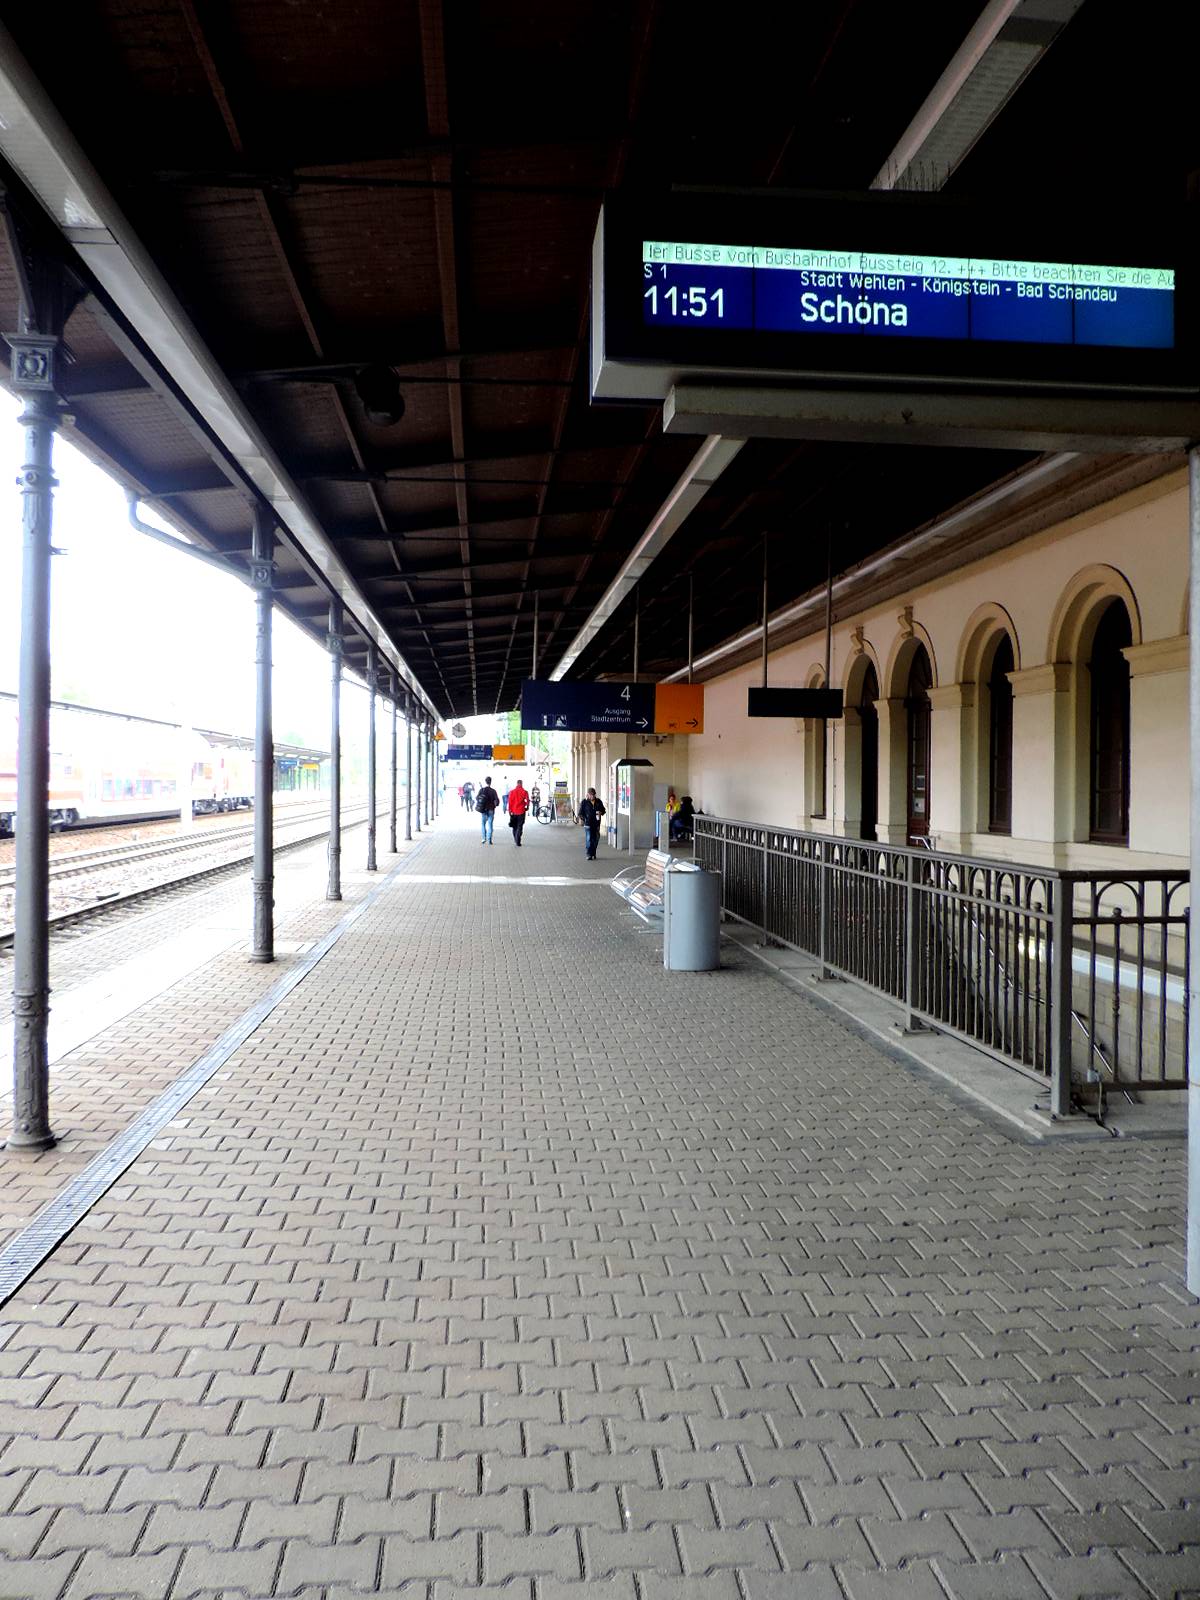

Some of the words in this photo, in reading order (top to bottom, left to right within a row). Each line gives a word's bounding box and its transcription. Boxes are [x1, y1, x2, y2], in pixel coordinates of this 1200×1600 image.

[643, 263, 653, 279] S
[660, 264, 667, 279] 1
[675, 246, 721, 262] Busse
[727, 250, 760, 264] vom
[765, 250, 853, 269] Busbahnhof
[860, 255, 924, 275] Bussteig
[992, 262, 1028, 278] Bitte
[1033, 265, 1101, 281] beachten
[1106, 268, 1127, 283] Sie
[1131, 270, 1152, 285] die
[800, 271, 843, 288] Stadt
[849, 273, 905, 291] Wehlen
[922, 277, 1000, 297] Königstein
[1017, 282, 1044, 298] Bad
[1048, 284, 1118, 302] Schandau
[643, 285, 724, 318] 11:51
[800, 292, 908, 327] Schöna
[620, 685, 631, 701] 4
[591, 714, 631, 723] Stadtzentrum
[604, 708, 631, 716] Ausgang
